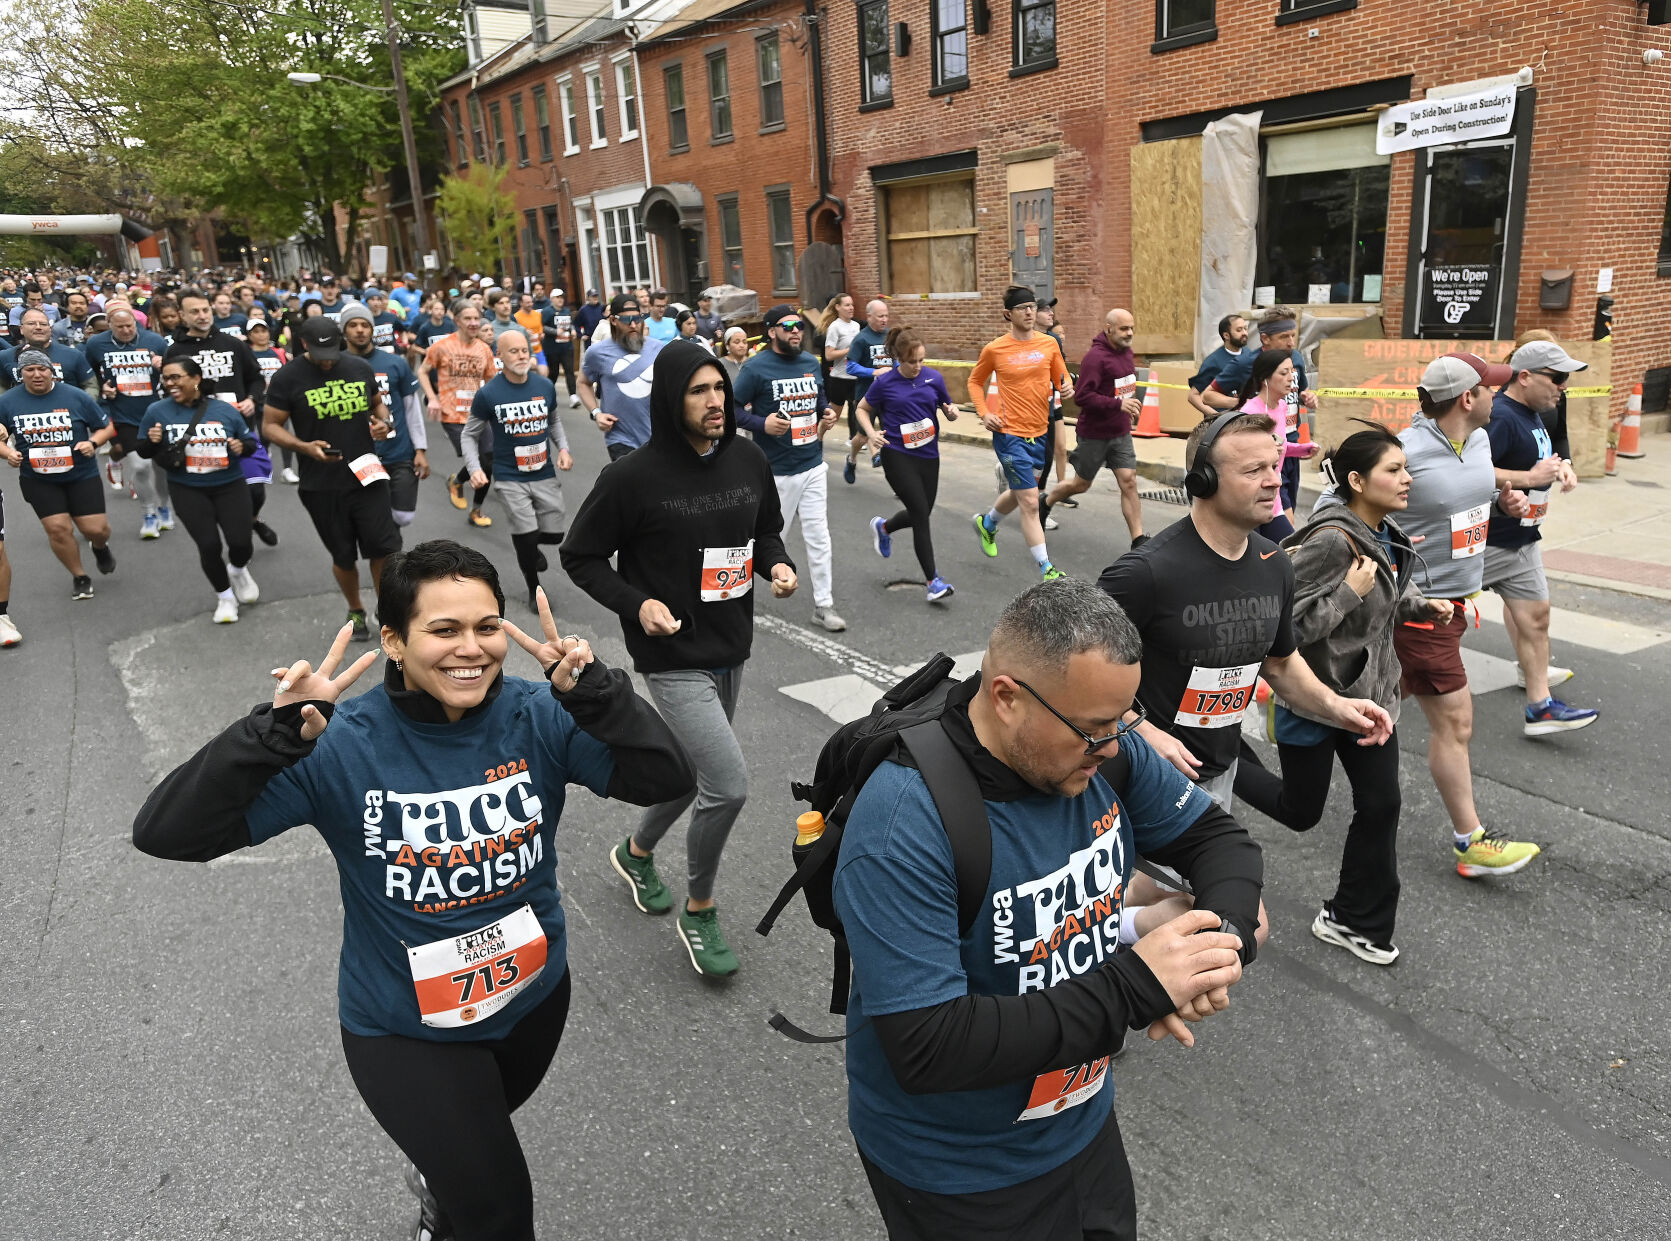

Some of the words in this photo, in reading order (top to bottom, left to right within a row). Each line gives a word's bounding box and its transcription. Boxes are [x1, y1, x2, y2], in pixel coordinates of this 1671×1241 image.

[1410, 112, 1420, 121] Use
[1422, 109, 1436, 119] Side
[1438, 106, 1452, 116] Door
[1454, 103, 1468, 114] Like
[1479, 94, 1512, 109] Sunday's
[1412, 127, 1430, 138] Open
[1432, 123, 1456, 134] During
[1458, 113, 1508, 129] Construction!
[32, 221, 59, 229] ywca
[1432, 269, 1460, 282] We're
[1462, 268, 1488, 284] Open
[191, 351, 234, 368] EAST
[304, 381, 366, 406] BEAST
[780, 398, 818, 412] RACISM
[314, 395, 369, 419] MODE
[23, 430, 74, 444] RACISM
[504, 420, 548, 434] RACISM
[660, 499, 688, 510] THIS
[692, 492, 722, 505] ONE'S
[680, 505, 702, 516] THE
[704, 498, 740, 512] COOKIE
[1464, 524, 1488, 546] 787
[716, 564, 747, 588] 974
[1182, 595, 1280, 628] OKLAHOMA
[1216, 620, 1265, 646] STATE
[1219, 680, 1240, 688] RACISM
[1196, 690, 1245, 714] 1798
[484, 758, 528, 783] 2024
[386, 770, 543, 854] race
[363, 790, 387, 860] ywca
[394, 820, 539, 868] AGAINST
[386, 832, 543, 902] RACISM
[992, 888, 1020, 965] ywca
[1029, 882, 1122, 965] AGAINS
[462, 923, 504, 951] race
[466, 936, 502, 954] AGAINST
[464, 940, 506, 963] RACISM
[1018, 913, 1120, 996] RACIS
[451, 952, 520, 1004] 713
